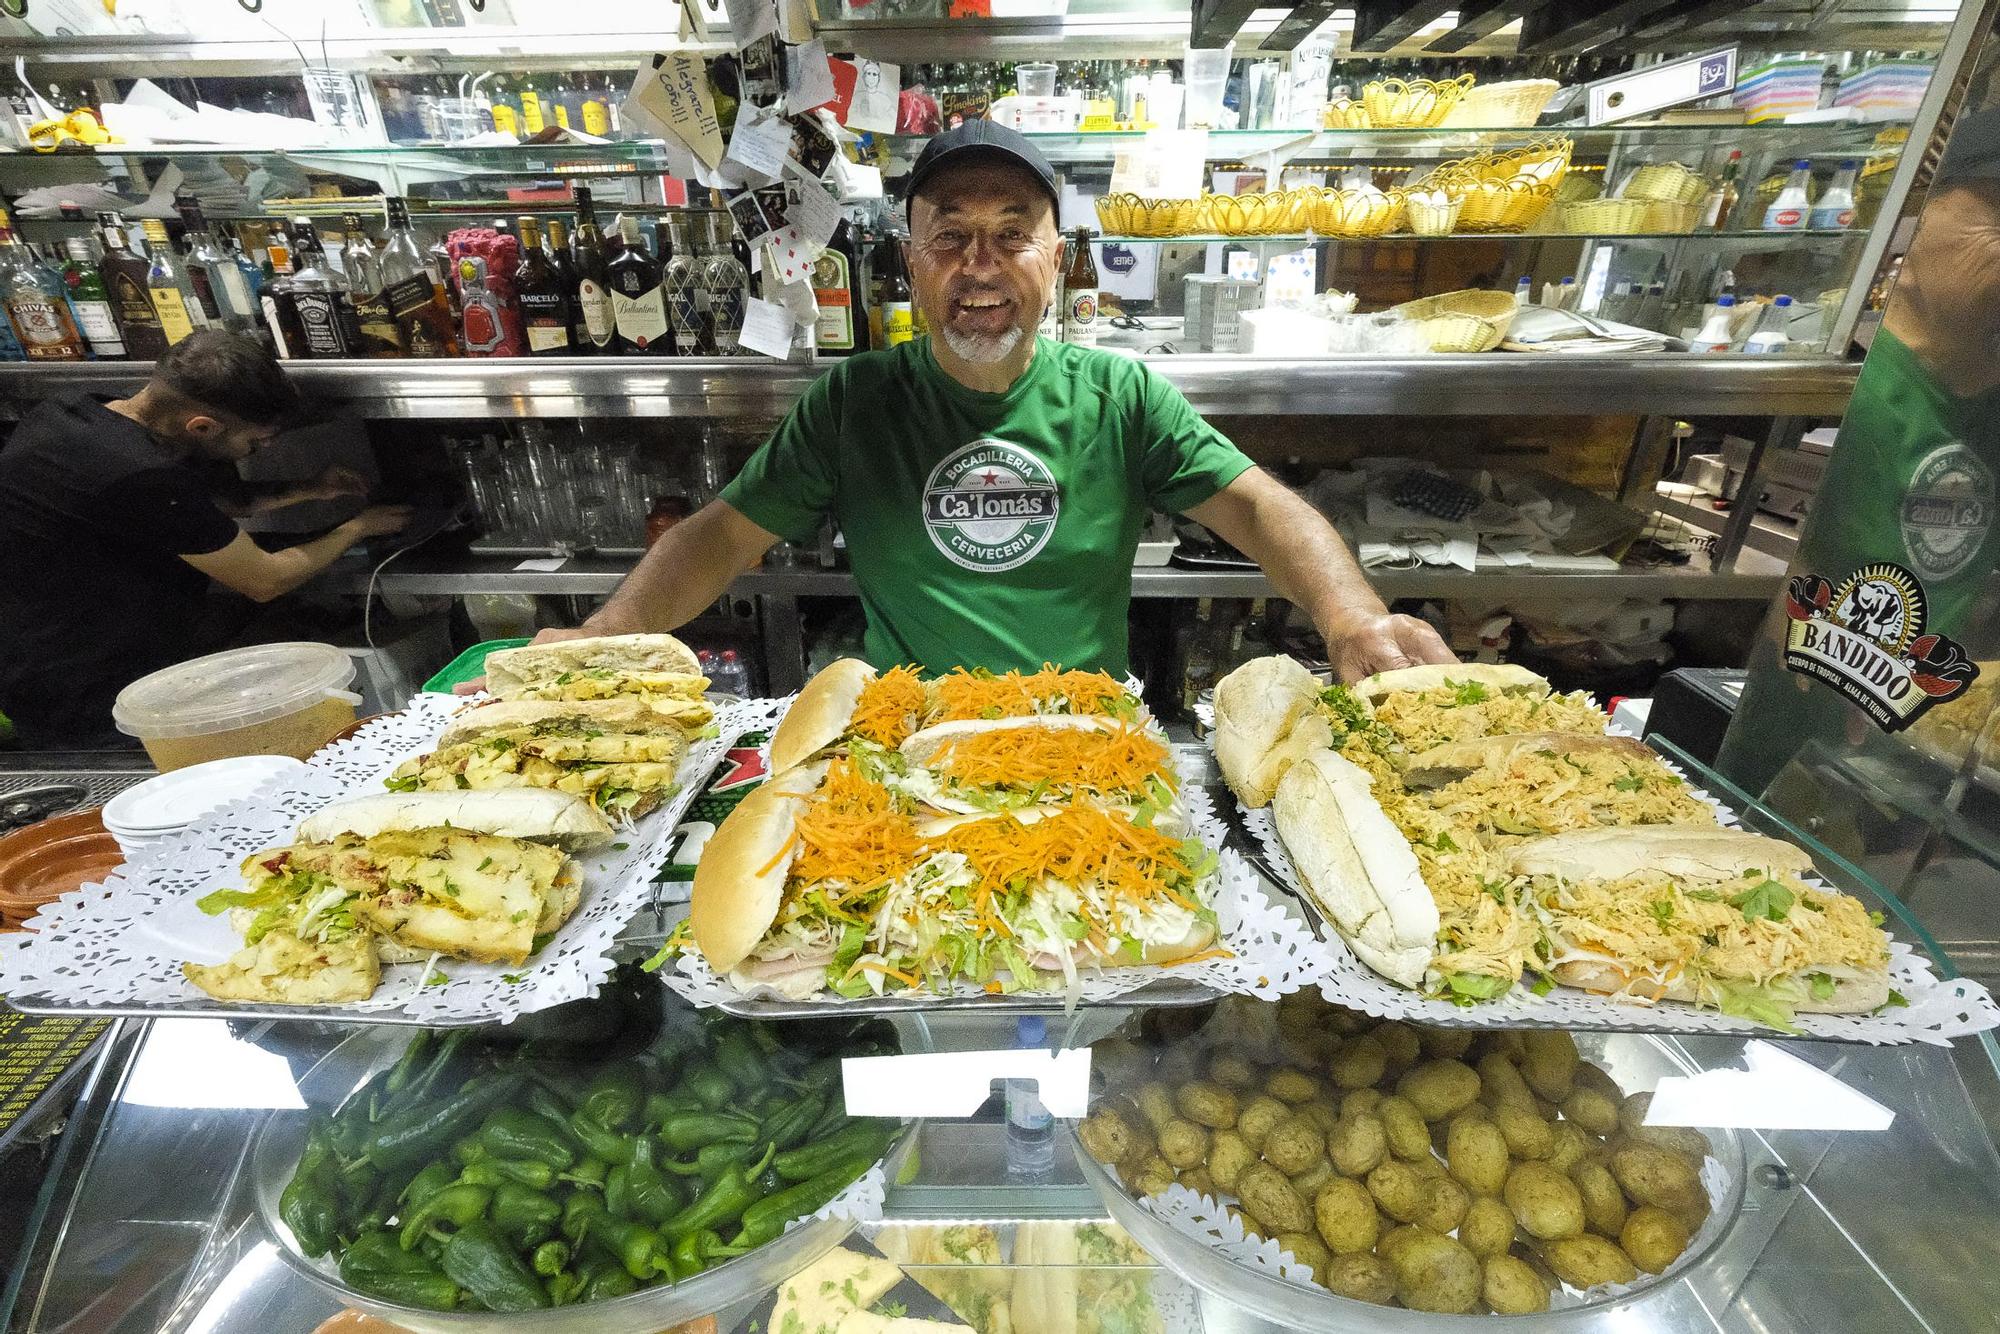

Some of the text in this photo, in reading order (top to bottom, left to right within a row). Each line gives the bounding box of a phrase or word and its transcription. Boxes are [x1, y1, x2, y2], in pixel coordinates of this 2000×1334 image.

[13, 304, 55, 313] CHIVAS
[520, 294, 560, 303] BARCELÓ
[61, 346, 72, 354] 12
[945, 451, 1034, 481] BOCADILLERIA
[939, 493, 1043, 519] Ca'Jonás
[951, 532, 1035, 560] CERVECERIA
[1801, 622, 1912, 701] BANDIDO
[1788, 655, 1892, 725] CUERPO DE TROPICAL ALMA DE TEQUILA
